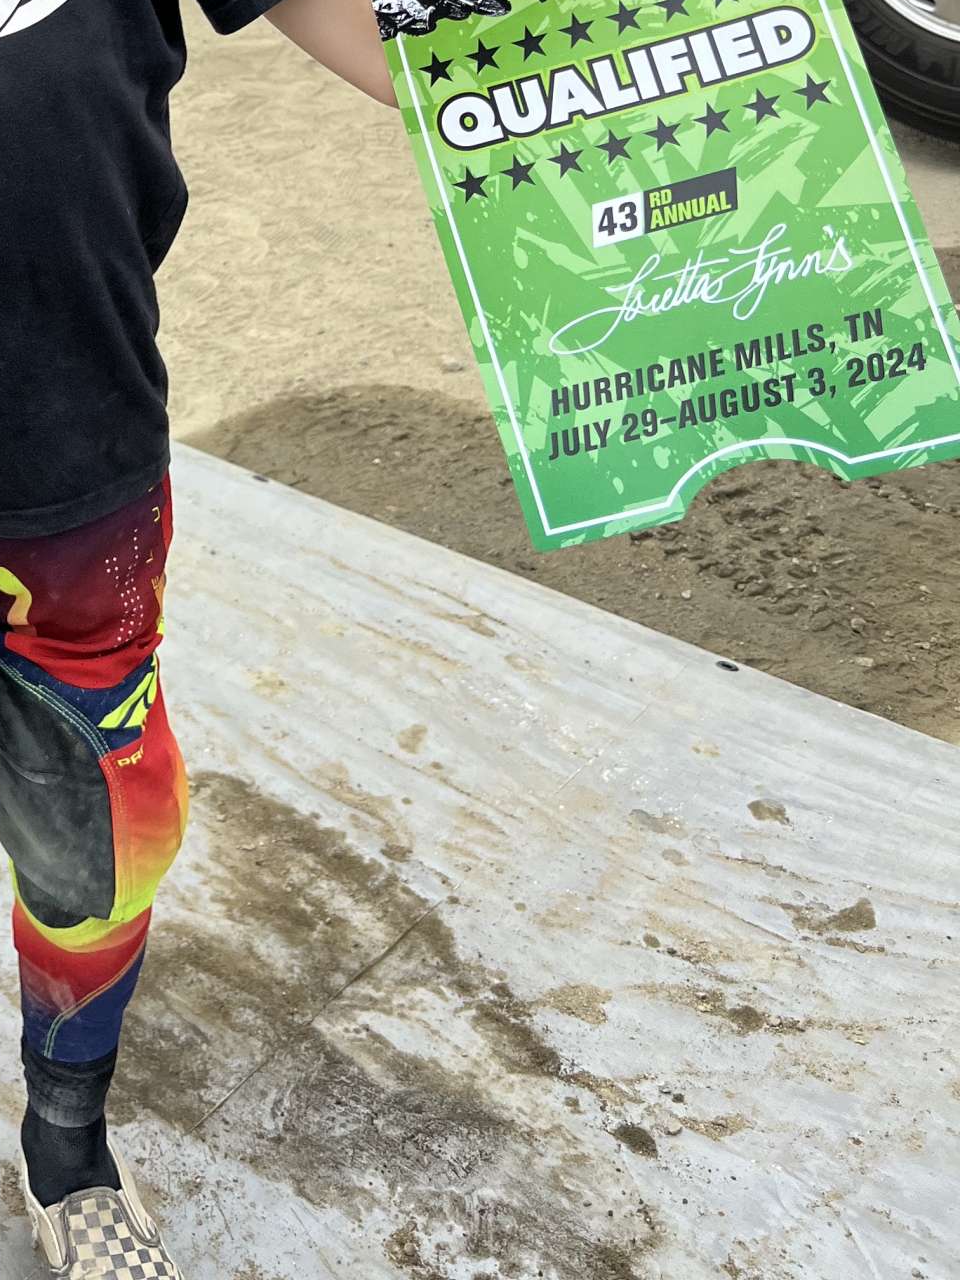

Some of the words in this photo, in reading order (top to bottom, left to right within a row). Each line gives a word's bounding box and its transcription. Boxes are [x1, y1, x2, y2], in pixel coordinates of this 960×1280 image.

[439, 10, 814, 150] QUALIFIED
[598, 201, 638, 237] 43
[649, 188, 672, 208] RD
[649, 191, 731, 229] ANNUAL
[549, 249, 730, 354] Loretta
[729, 224, 853, 321] Lynn's
[549, 419, 612, 460] JULY
[808, 367, 837, 399] 3,
[846, 342, 927, 388] 2024
[551, 348, 726, 417] HURRICANE
[735, 323, 836, 371] MILLS,
[844, 308, 885, 343] TN
